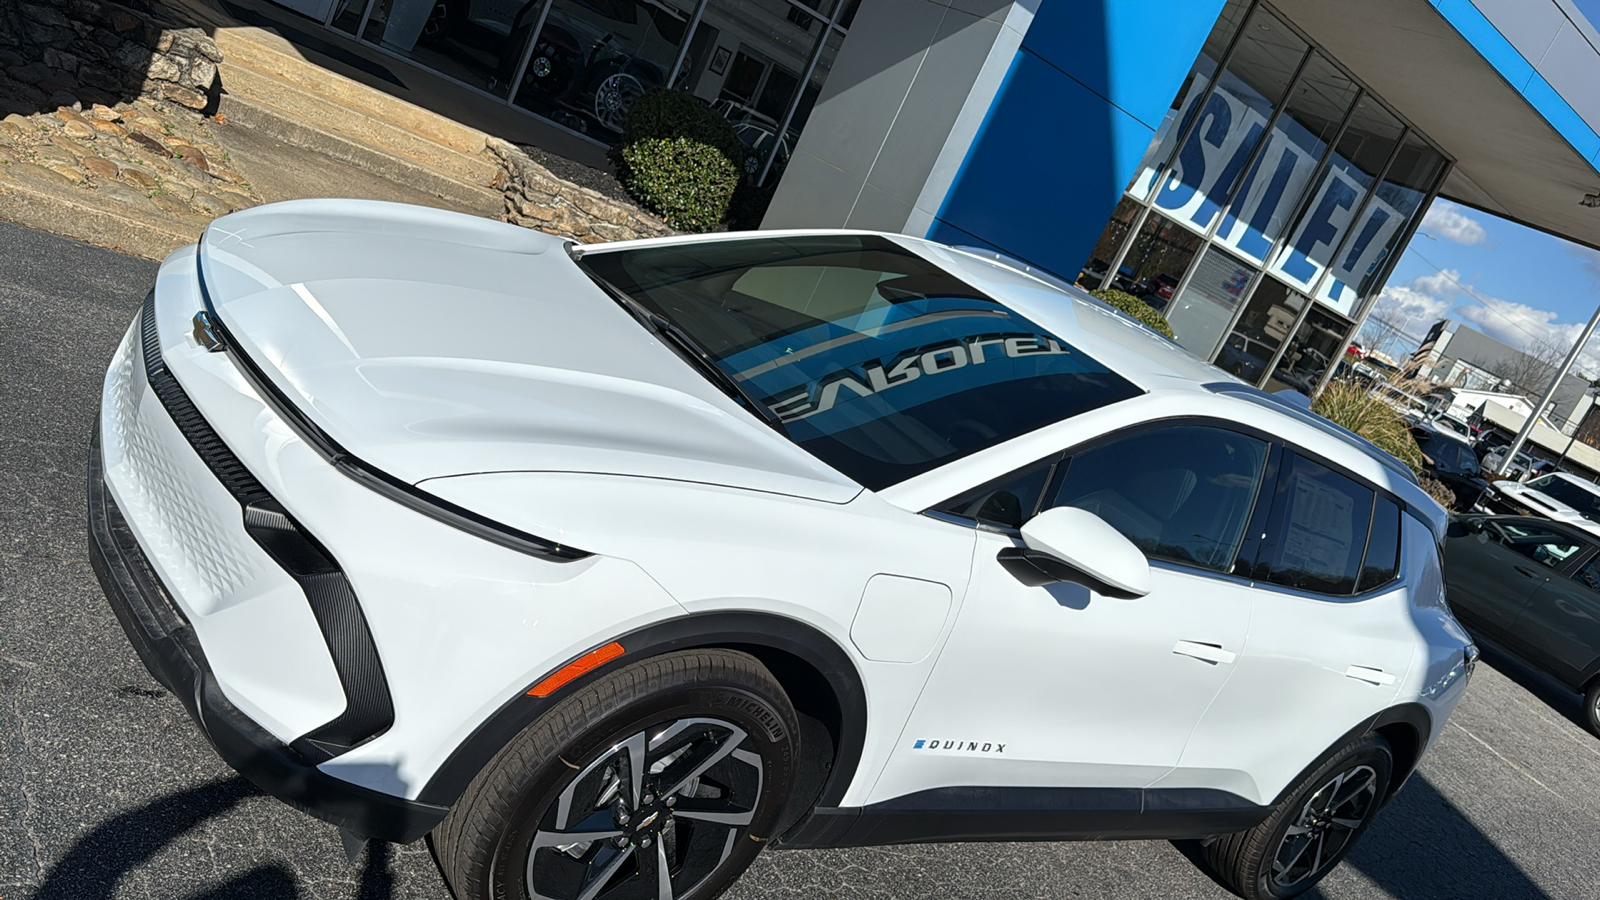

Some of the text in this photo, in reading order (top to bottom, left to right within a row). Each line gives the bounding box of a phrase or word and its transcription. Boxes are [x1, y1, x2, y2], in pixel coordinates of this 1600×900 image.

[1148, 91, 1391, 303] SALE!
[726, 696, 784, 739] MICHELIN
[913, 739, 1006, 753] EQUINOX
